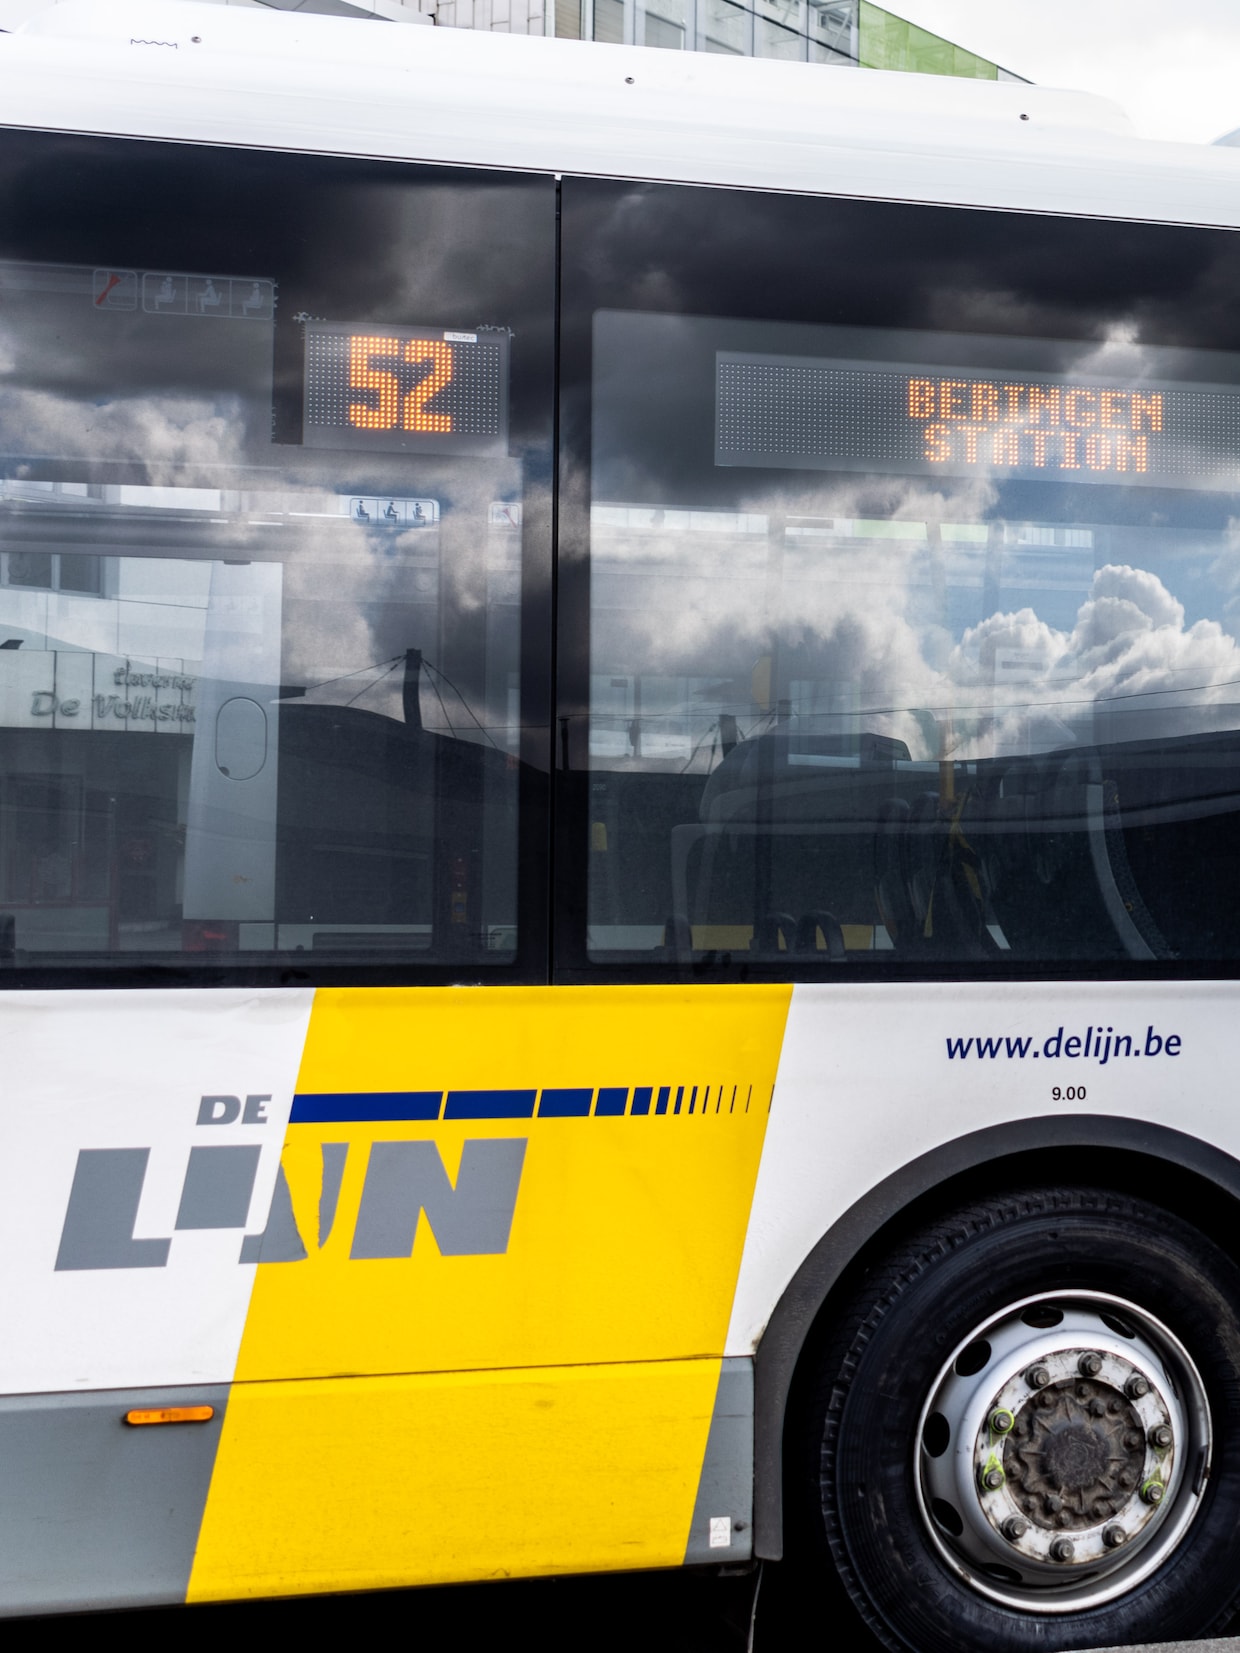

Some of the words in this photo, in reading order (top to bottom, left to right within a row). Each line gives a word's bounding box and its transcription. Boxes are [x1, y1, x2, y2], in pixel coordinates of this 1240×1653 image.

[350, 335, 452, 432] 52
[909, 379, 1163, 431] BERINGEN
[924, 424, 1147, 472] STATION
[31, 690, 81, 717] De
[946, 1026, 1182, 1065] www.delijn.be
[195, 1094, 272, 1126] DE
[1052, 1086, 1087, 1101] 9.00
[54, 1137, 528, 1272] LIJN
